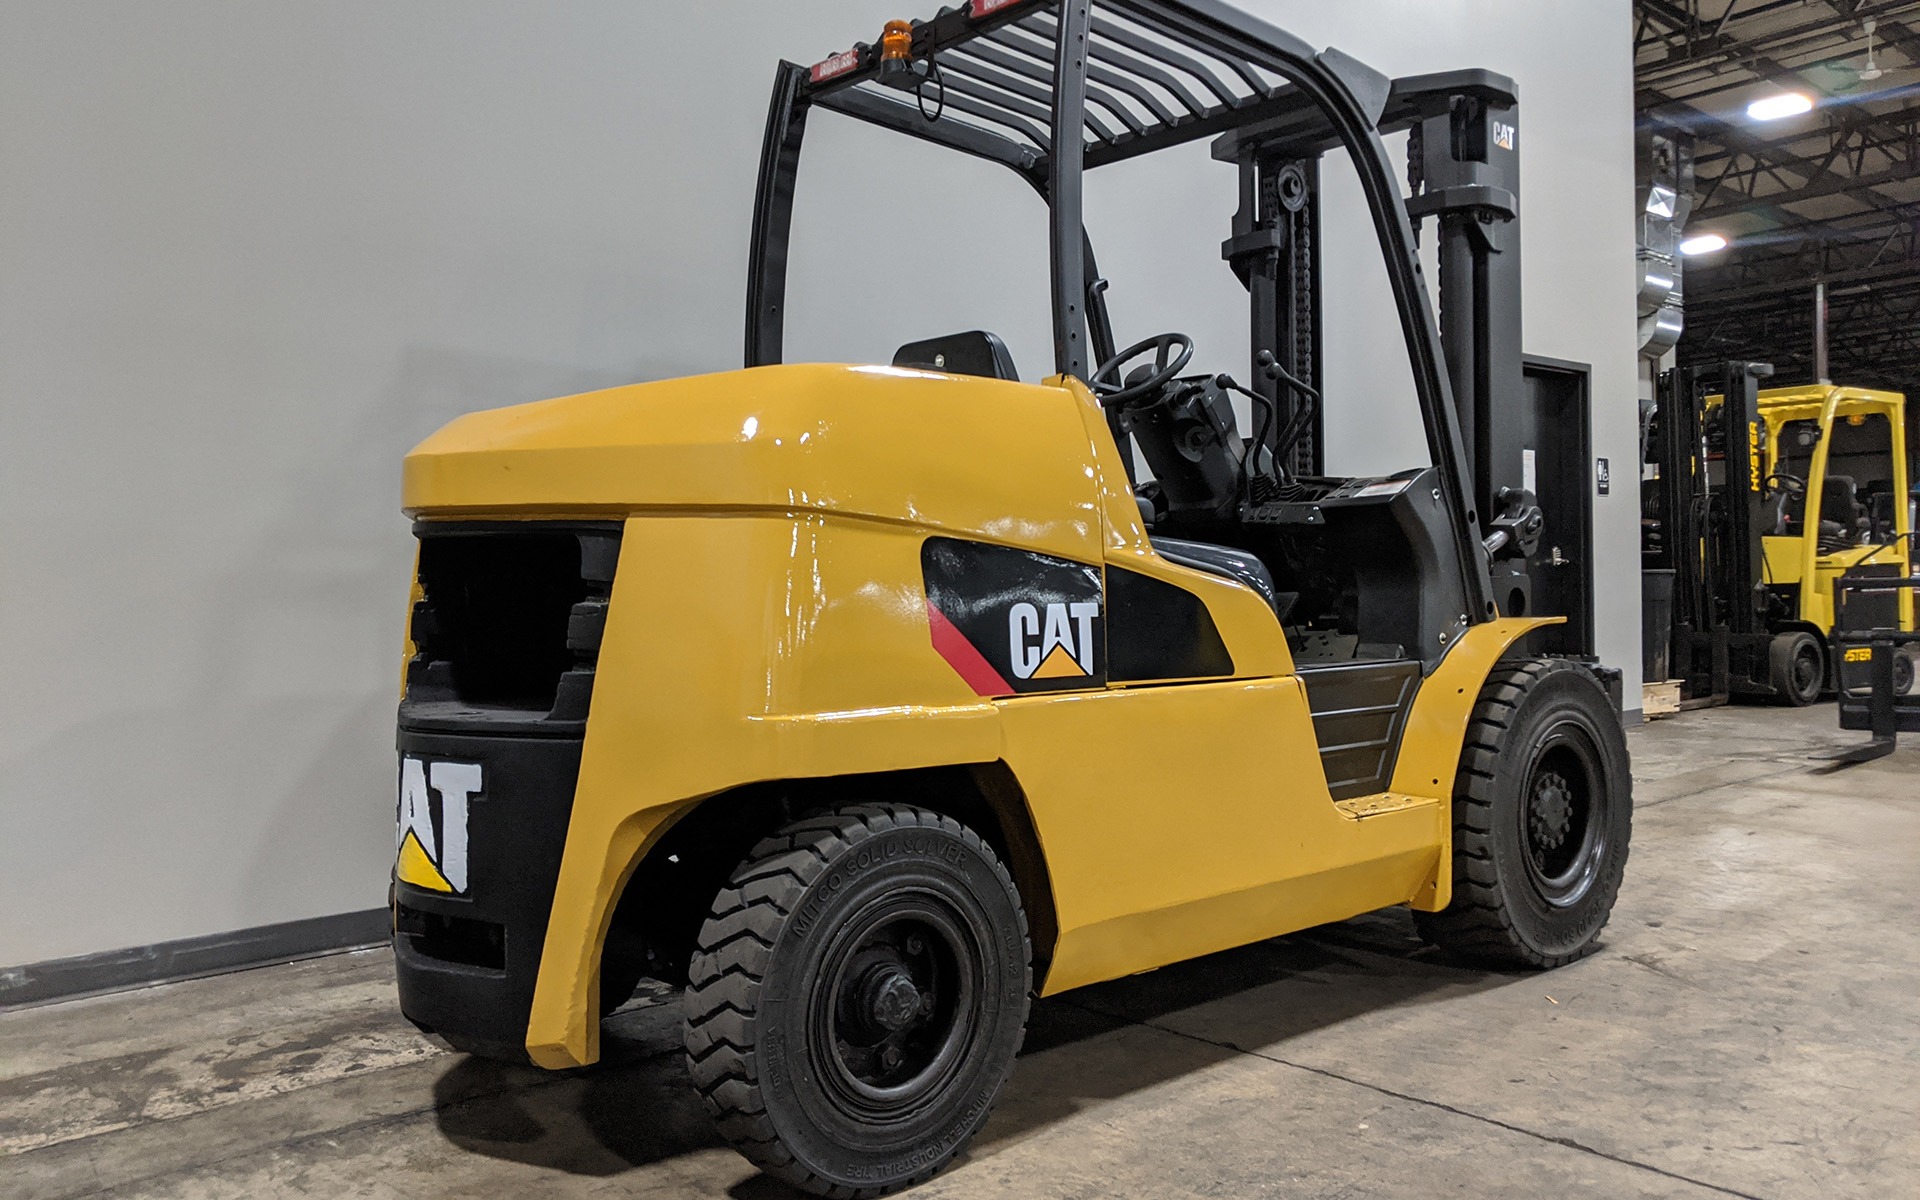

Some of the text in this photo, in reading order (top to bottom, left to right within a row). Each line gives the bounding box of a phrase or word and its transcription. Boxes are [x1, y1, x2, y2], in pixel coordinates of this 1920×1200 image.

[1493, 121, 1515, 150] CAT
[1749, 421, 1760, 491] HYSTER
[1009, 602, 1099, 680] CAT
[398, 757, 482, 894] AT
[792, 872, 842, 938] MITCO
[845, 842, 898, 876] SOLID
